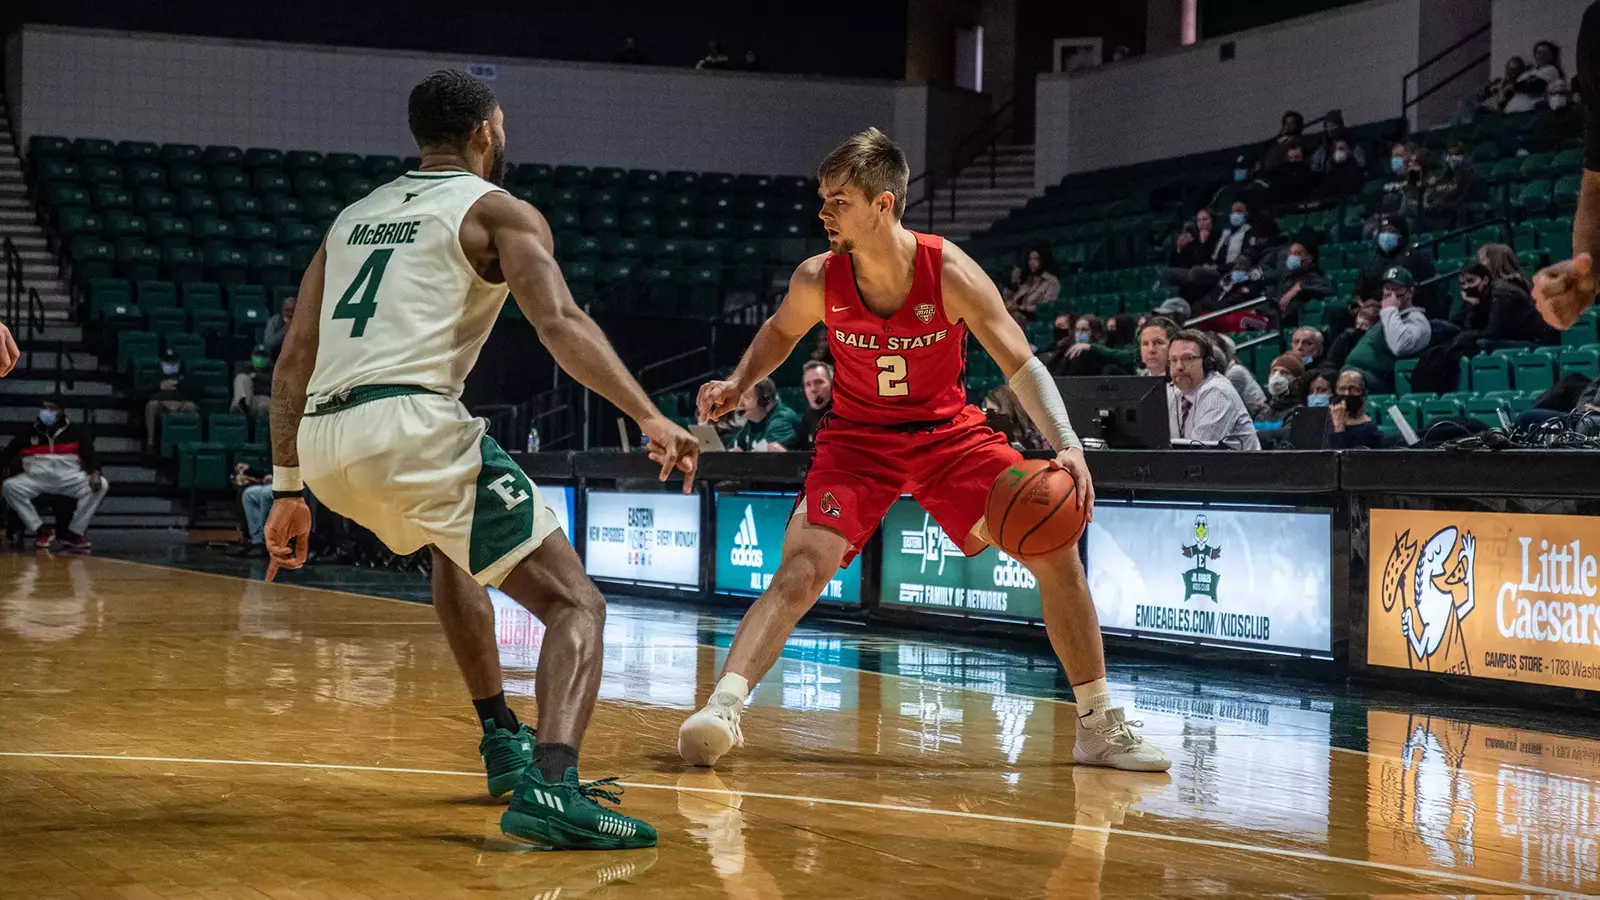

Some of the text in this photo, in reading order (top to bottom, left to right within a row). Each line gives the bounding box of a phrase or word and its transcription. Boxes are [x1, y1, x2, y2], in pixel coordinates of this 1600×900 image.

[347, 220, 421, 246] McBRIDE
[331, 248, 395, 338] 4
[834, 328, 949, 351] BALL STATE
[874, 354, 910, 397] 2
[487, 472, 530, 511] E
[731, 546, 762, 567] adidas
[1518, 536, 1598, 597] Little
[993, 562, 1036, 589] adidas
[925, 585, 953, 606] FAMILY
[955, 588, 964, 607] OF
[966, 589, 1008, 611] NETWORKS
[1135, 604, 1270, 641] EMUEAGLES.COM/KIDSCLUB
[1484, 651, 1517, 670] CAMPUS
[1519, 655, 1543, 673] STORE
[1551, 658, 1570, 676] 1783
